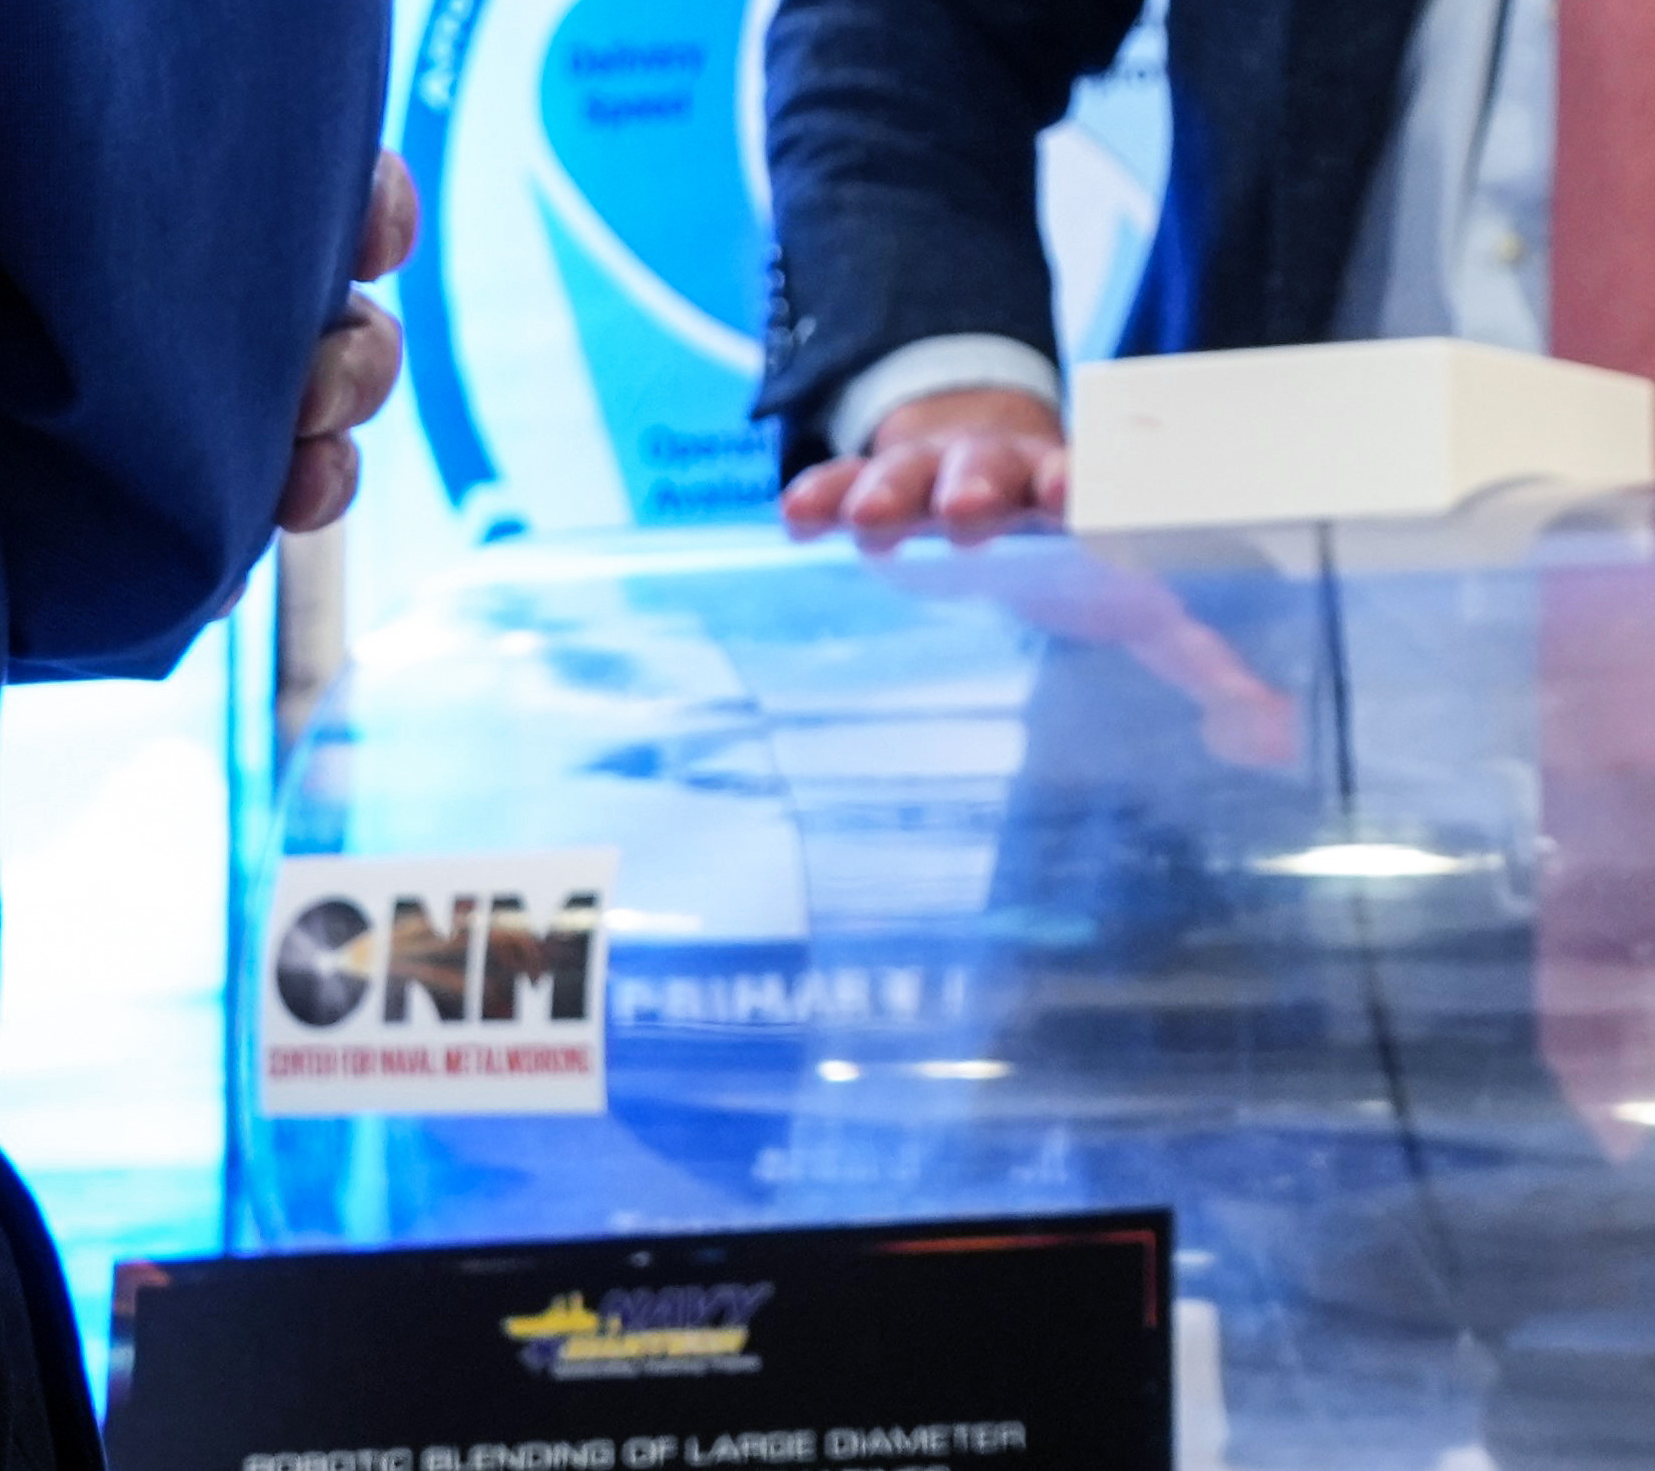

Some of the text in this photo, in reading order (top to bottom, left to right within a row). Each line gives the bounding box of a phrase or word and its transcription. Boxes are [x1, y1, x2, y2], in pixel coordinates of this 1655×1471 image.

[276, 894, 600, 1027] CNM
[419, 1437, 616, 1471] BLENDING
[621, 1435, 679, 1471] OF
[684, 1429, 818, 1467] LARGE
[823, 1420, 1028, 1462] DIAMETER
